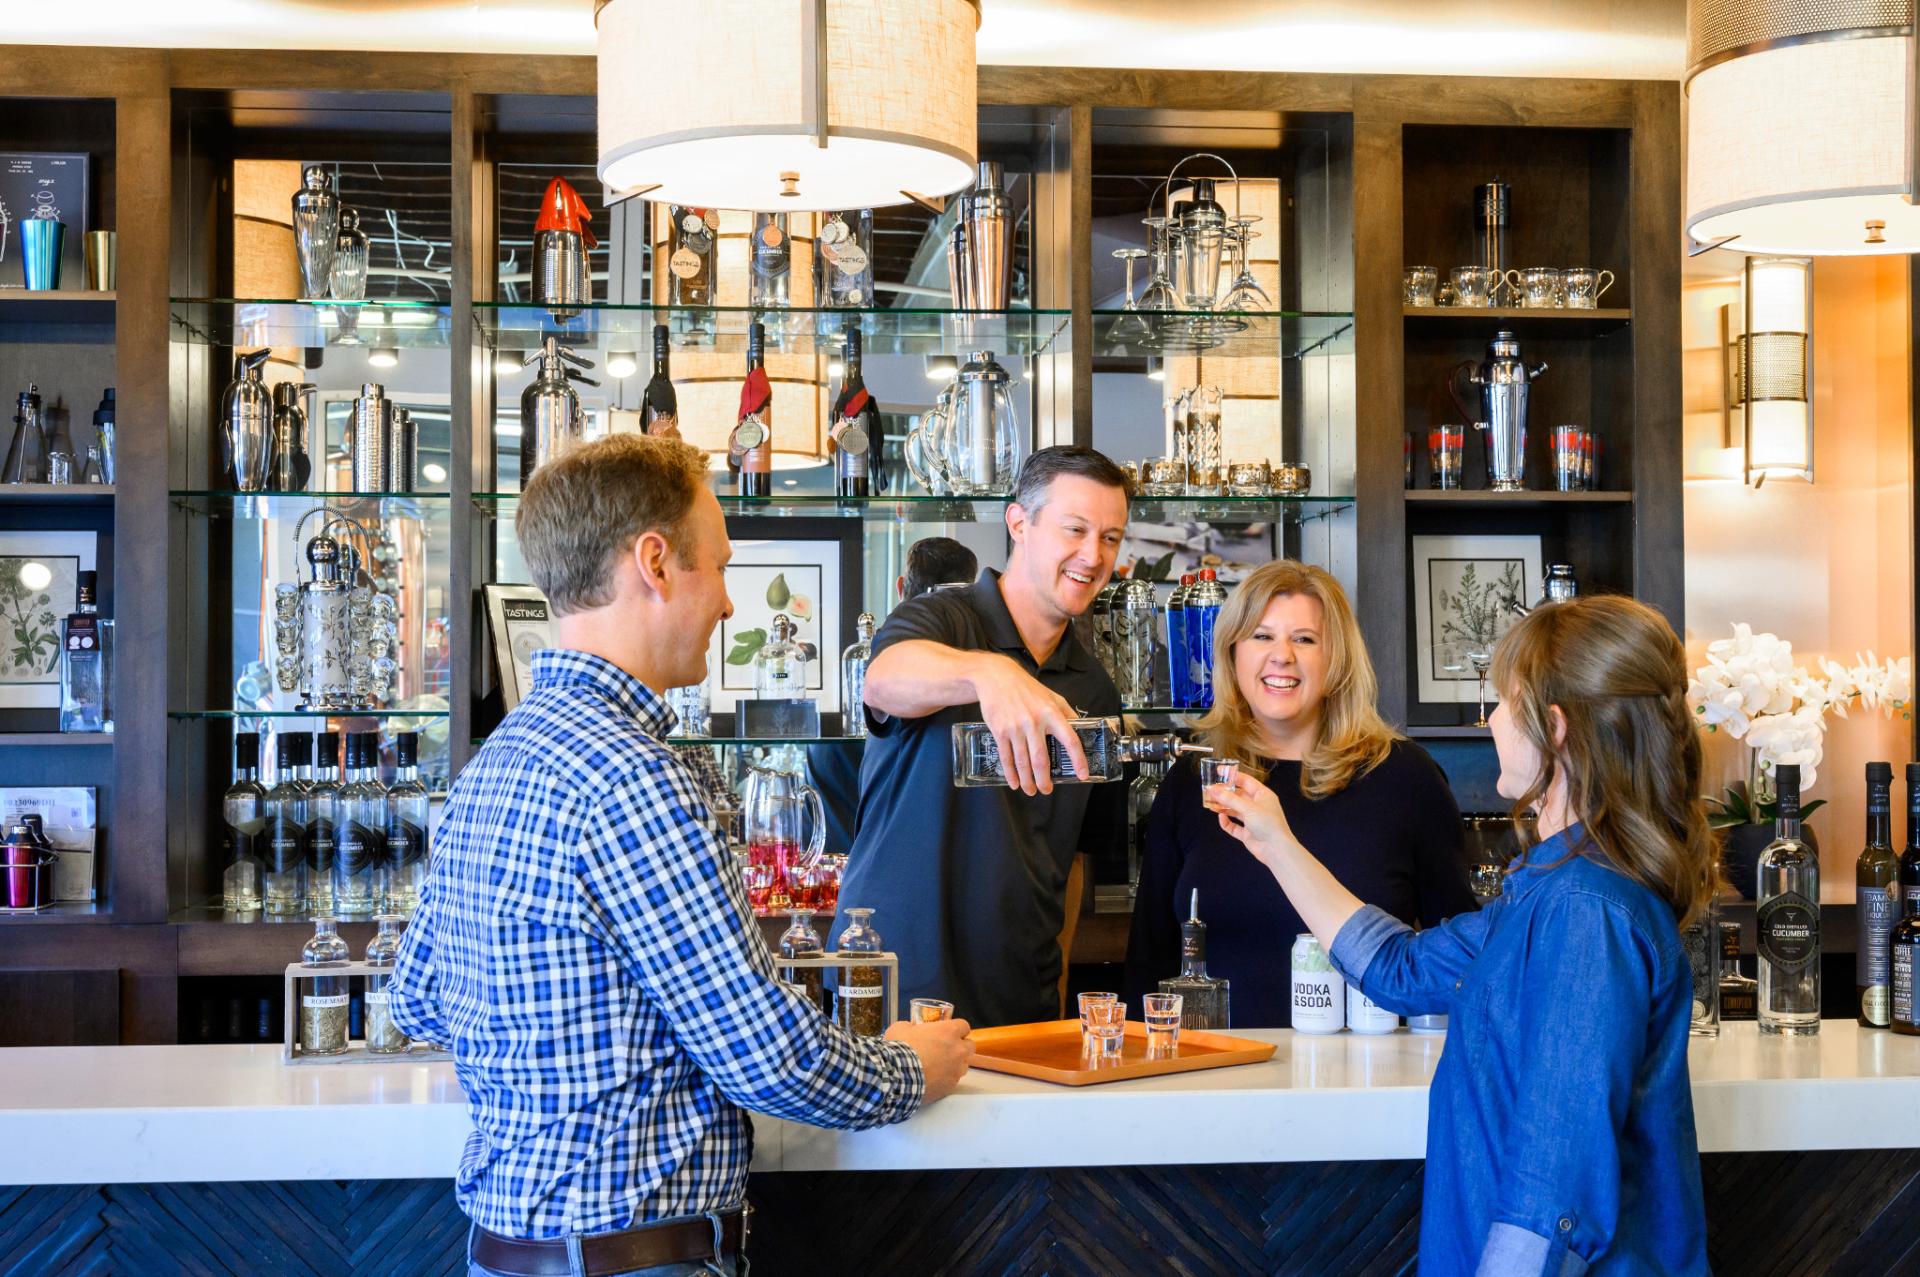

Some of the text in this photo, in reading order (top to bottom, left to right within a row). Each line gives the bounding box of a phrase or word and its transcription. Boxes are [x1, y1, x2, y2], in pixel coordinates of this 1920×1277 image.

[505, 608, 546, 618] TASTINGS
[1866, 902, 1890, 913] FINE
[1772, 929, 1810, 937] CUCUMBER
[1294, 982, 1331, 996] VODKA
[311, 996, 347, 1006] ROSEMARY
[1294, 996, 1333, 1008] &SODA
